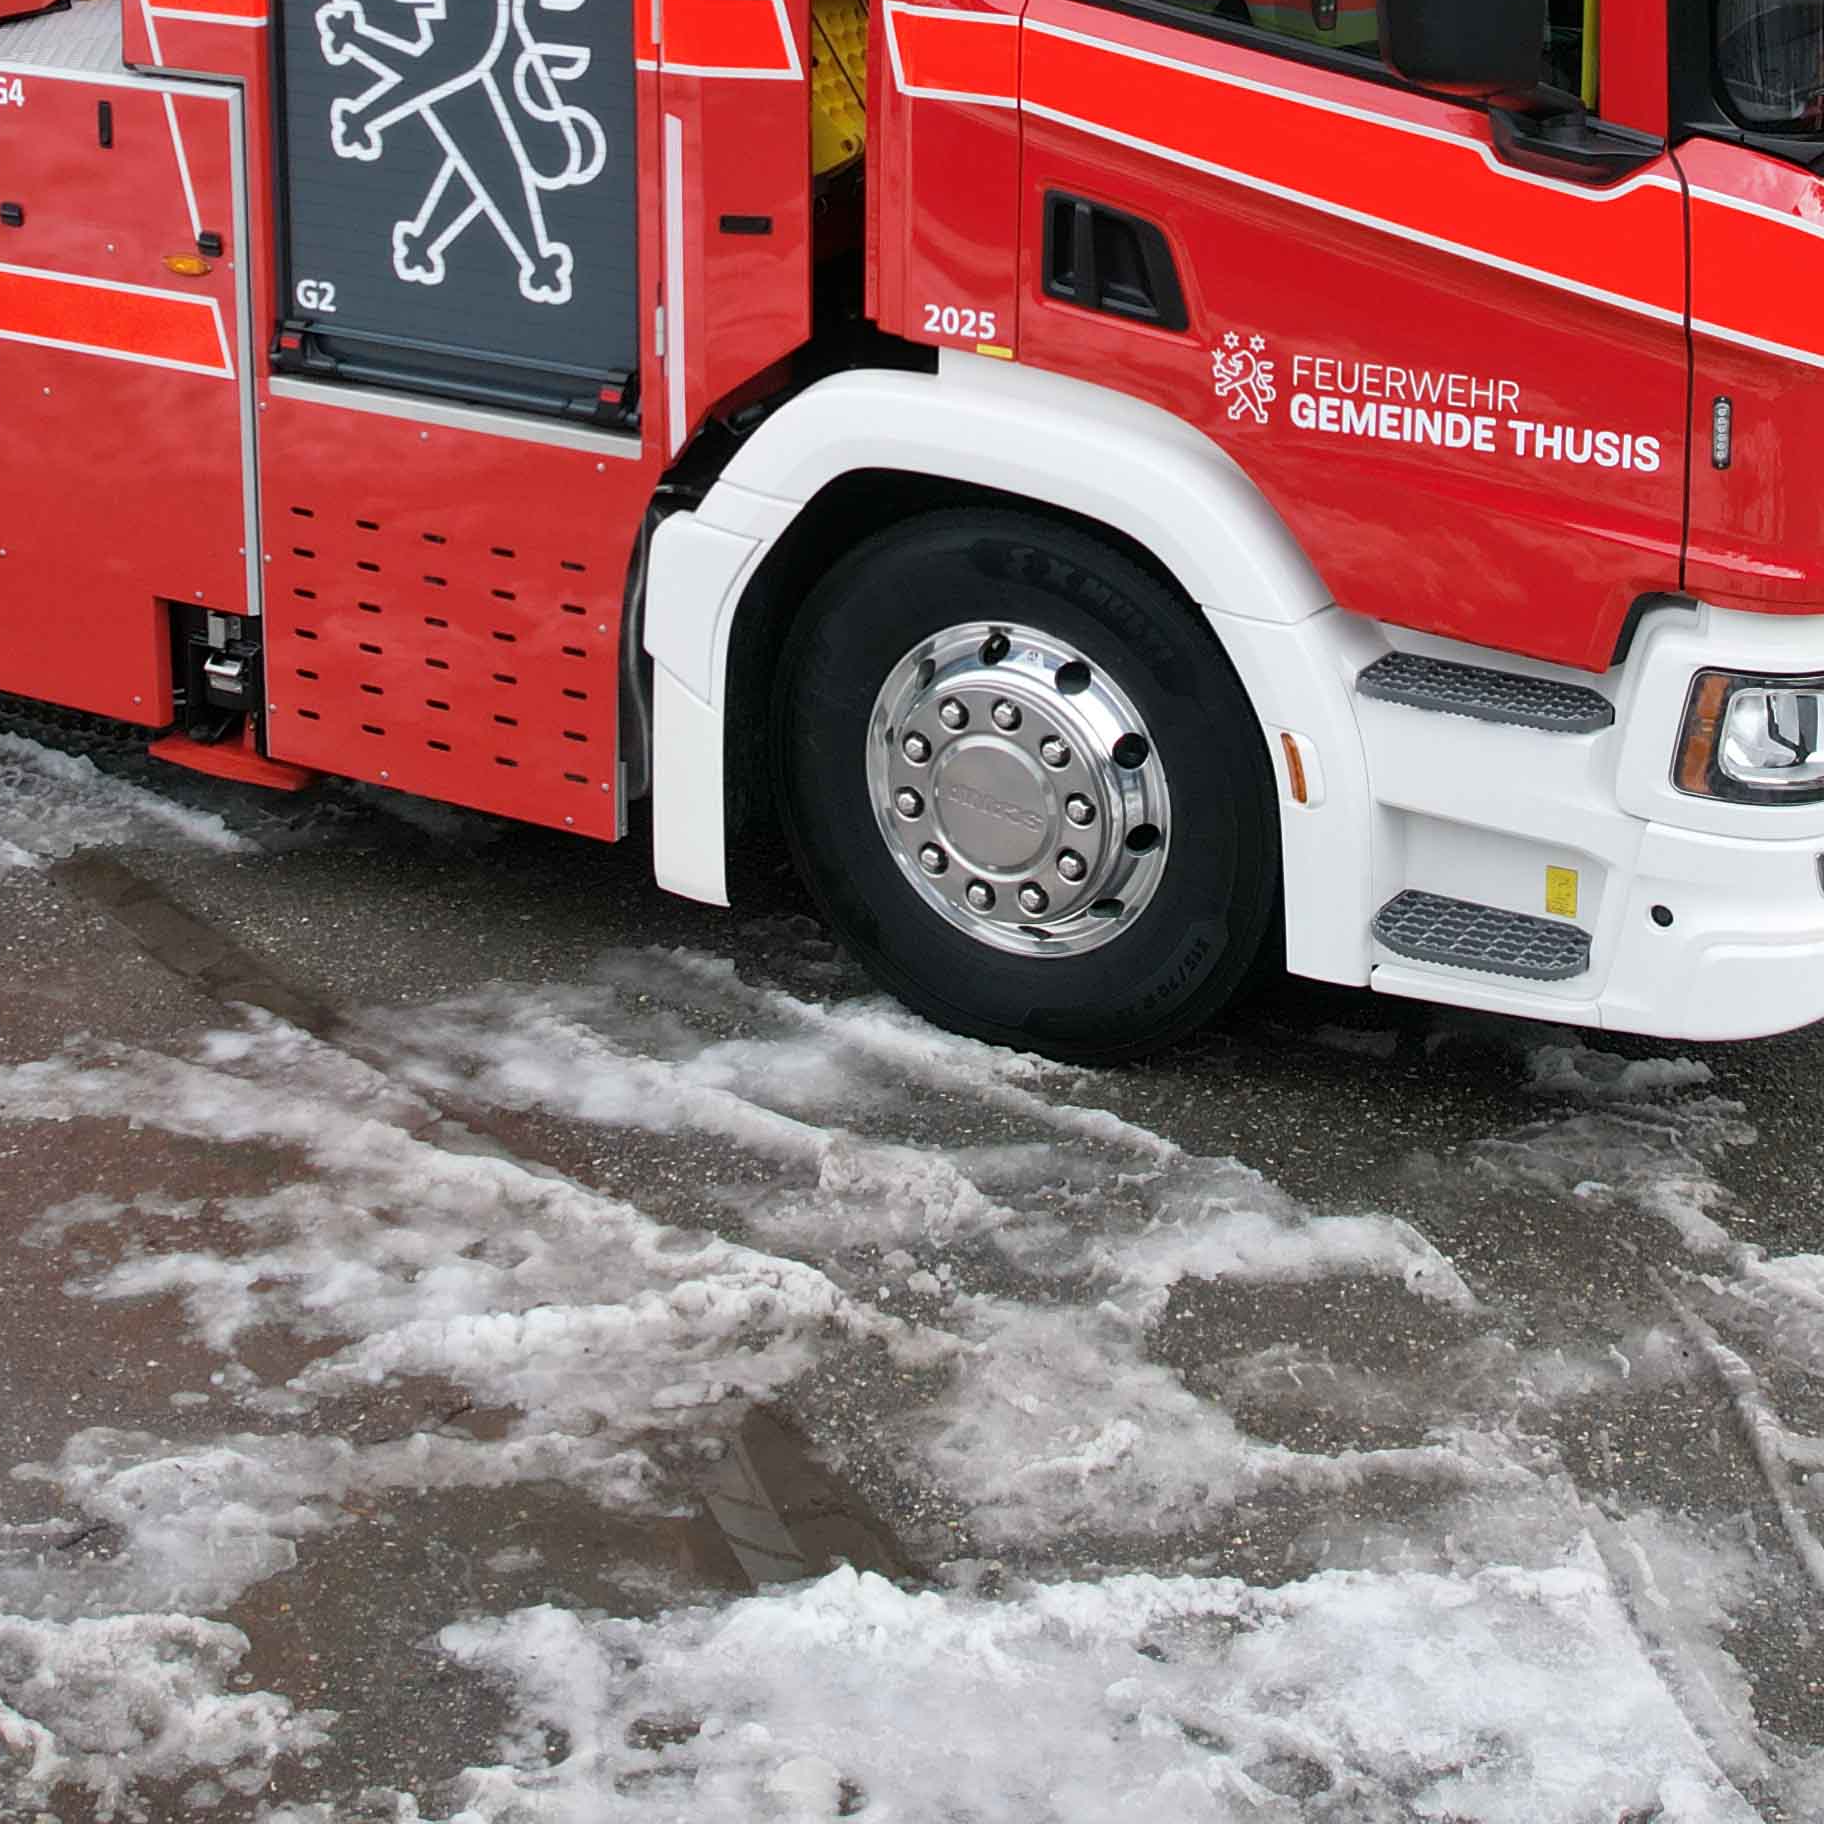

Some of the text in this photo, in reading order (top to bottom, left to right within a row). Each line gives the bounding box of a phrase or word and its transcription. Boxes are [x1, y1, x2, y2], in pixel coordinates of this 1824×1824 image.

[296, 279, 336, 313] G2
[923, 304, 997, 340] 2025
[1292, 355, 1520, 414] FEUERWEHR
[1290, 394, 1661, 472] GEMEINDE THUSIS
